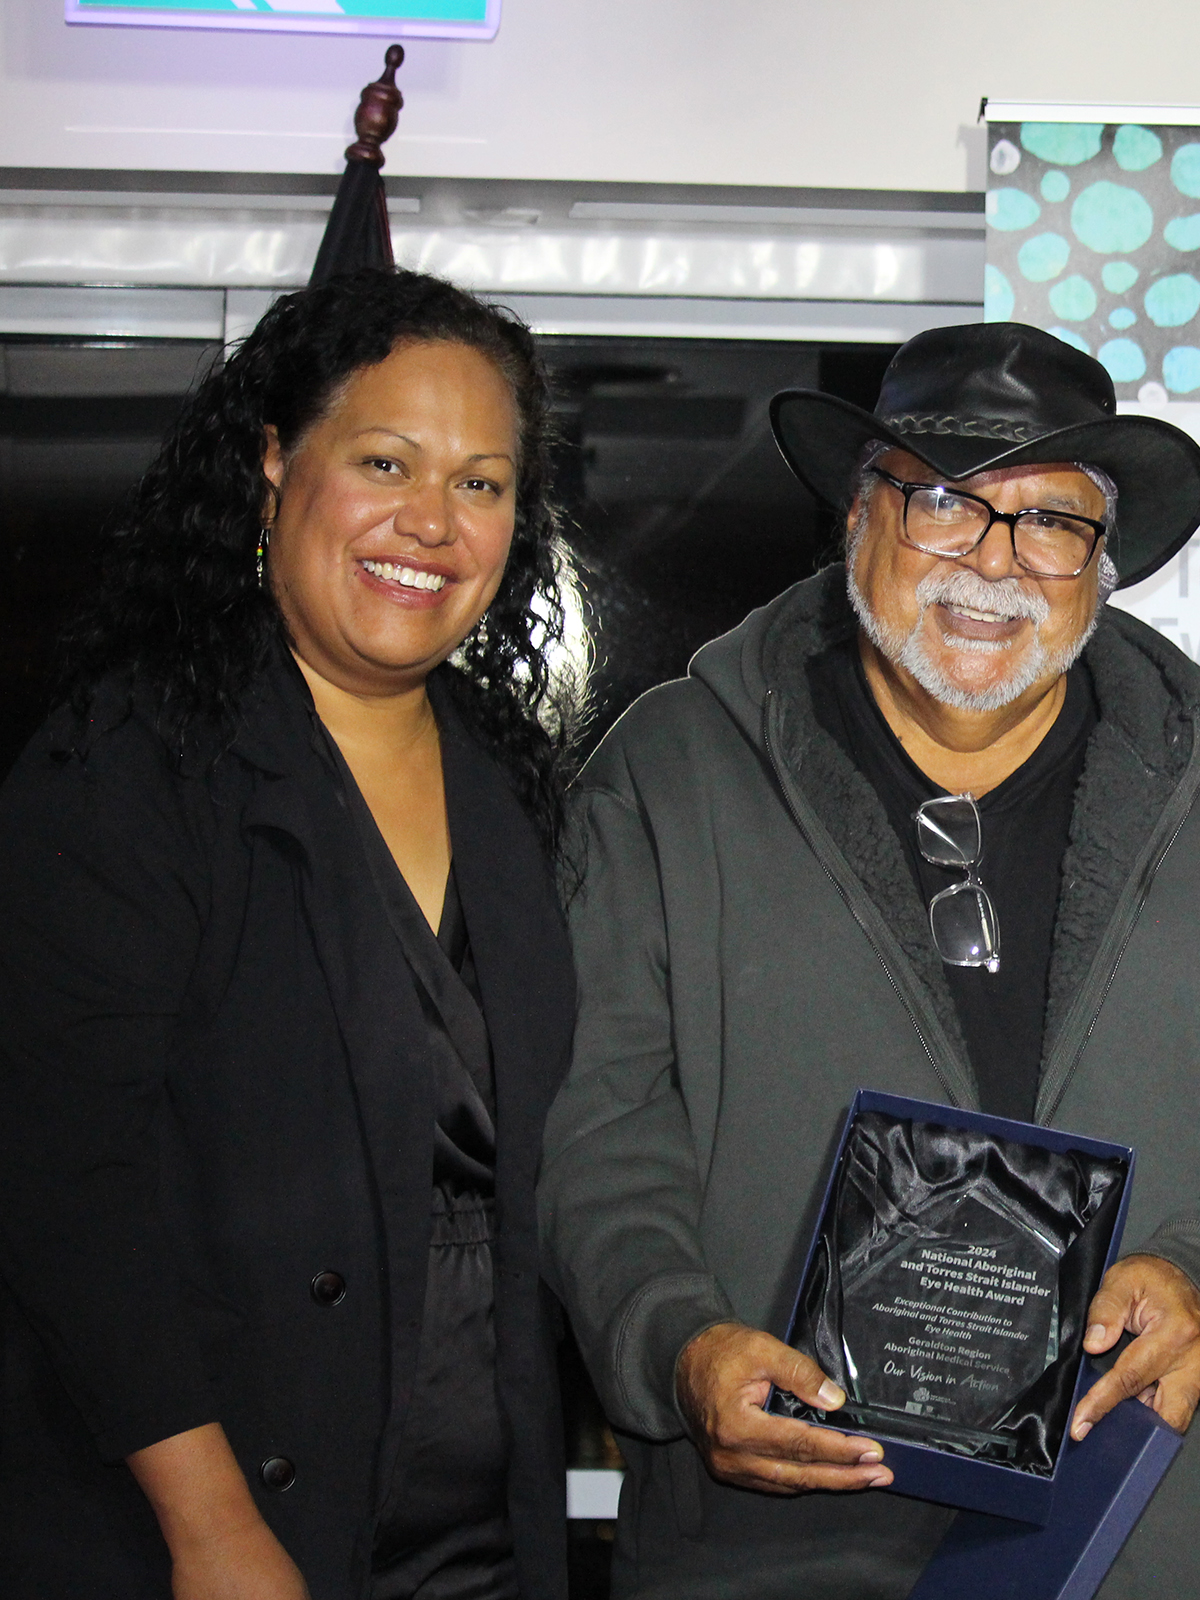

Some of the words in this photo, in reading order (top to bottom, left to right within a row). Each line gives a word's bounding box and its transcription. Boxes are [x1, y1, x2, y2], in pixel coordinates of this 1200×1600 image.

[921, 1249, 974, 1268] National
[973, 1260, 1037, 1281] Aboriginal
[966, 1244, 997, 1259] 2024
[900, 1260, 924, 1272] and
[926, 1264, 964, 1280] Torres
[965, 1272, 1000, 1288] Strait
[1001, 1278, 1052, 1298] Islander
[920, 1276, 942, 1290] Eye
[943, 1280, 985, 1298] Health
[985, 1289, 1026, 1306] Award
[872, 1302, 920, 1320] Aboriginal
[919, 1312, 938, 1323] and
[938, 1315, 966, 1328] Torres
[966, 1322, 992, 1334] Strait
[992, 1325, 1030, 1342] Islander
[894, 1296, 947, 1314] Exceptional
[946, 1306, 1002, 1326] Contribution
[1002, 1318, 1013, 1328] to
[908, 1336, 956, 1354] Geraldton
[957, 1346, 992, 1360] Region
[924, 1324, 942, 1335] Eye
[942, 1327, 972, 1341] Health
[884, 1342, 936, 1361] Aboriginal
[936, 1352, 974, 1368] Medical
[974, 1360, 1010, 1375] Service
[883, 1360, 906, 1376] Our
[910, 1364, 943, 1382] Vision
[945, 1374, 956, 1385] in
[960, 1373, 1000, 1392] Action
